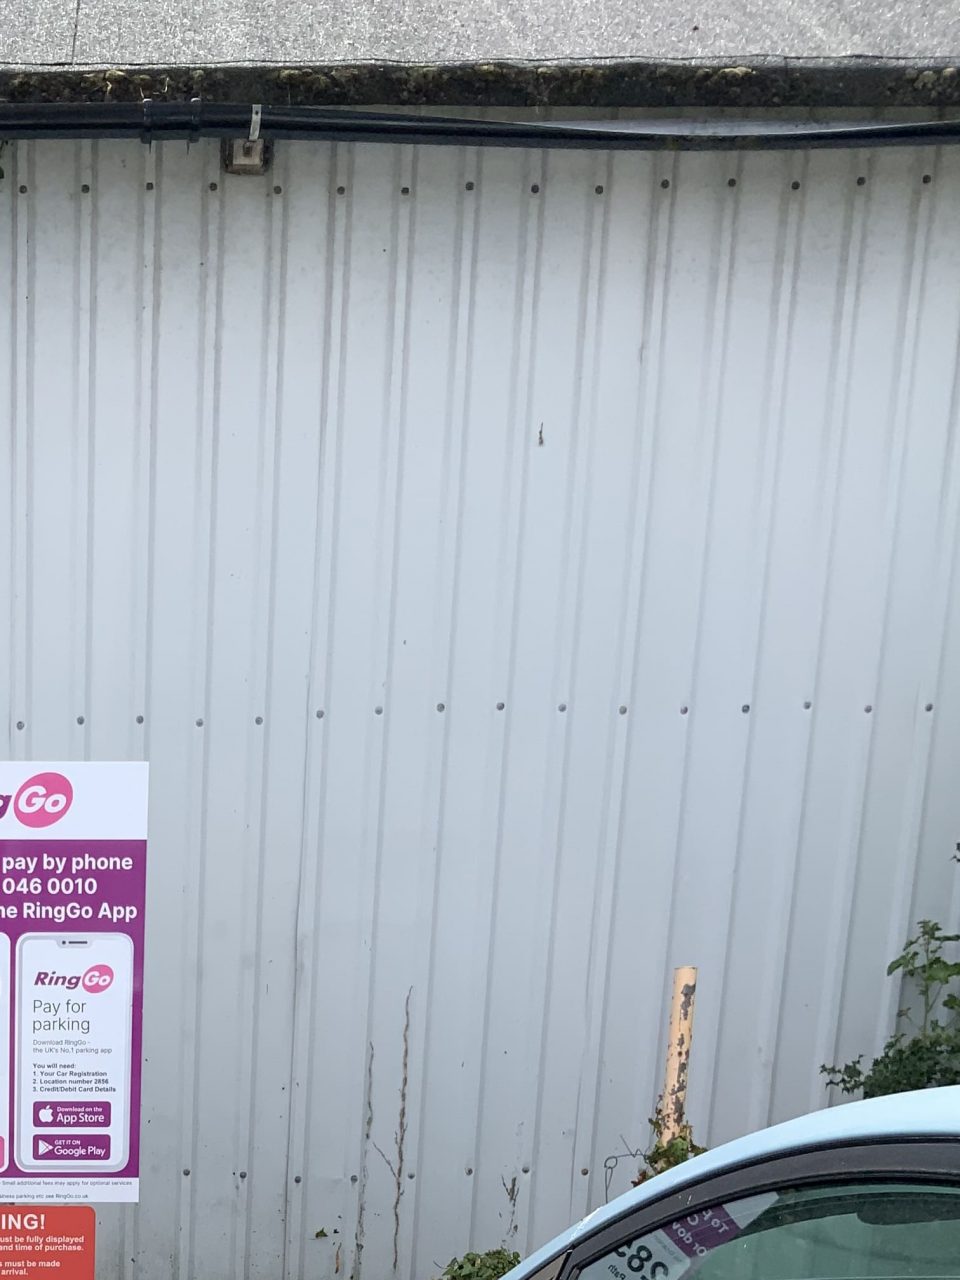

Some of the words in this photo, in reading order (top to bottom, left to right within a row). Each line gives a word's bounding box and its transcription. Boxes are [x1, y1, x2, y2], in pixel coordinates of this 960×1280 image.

[2, 856, 38, 873] pay
[42, 853, 67, 873] by
[71, 853, 134, 873] phone
[2, 877, 42, 894] 046
[46, 877, 98, 894] 0010
[22, 901, 93, 923] RingGo
[97, 901, 138, 923] App
[33, 970, 111, 990] RingGo
[32, 999, 61, 1016] Pay
[65, 999, 87, 1013] for
[31, 1017, 90, 1034] parking
[56, 1113, 78, 1124] App
[78, 1113, 105, 1122] Store
[54, 1146, 86, 1157] Google
[88, 1146, 105, 1157] Play
[26, 1236, 44, 1245] fully
[45, 1236, 85, 1245] displayed
[44, 1244, 84, 1253] purchase.
[4, 1260, 26, 1268] must
[26, 1260, 37, 1268] be
[38, 1260, 61, 1268] made
